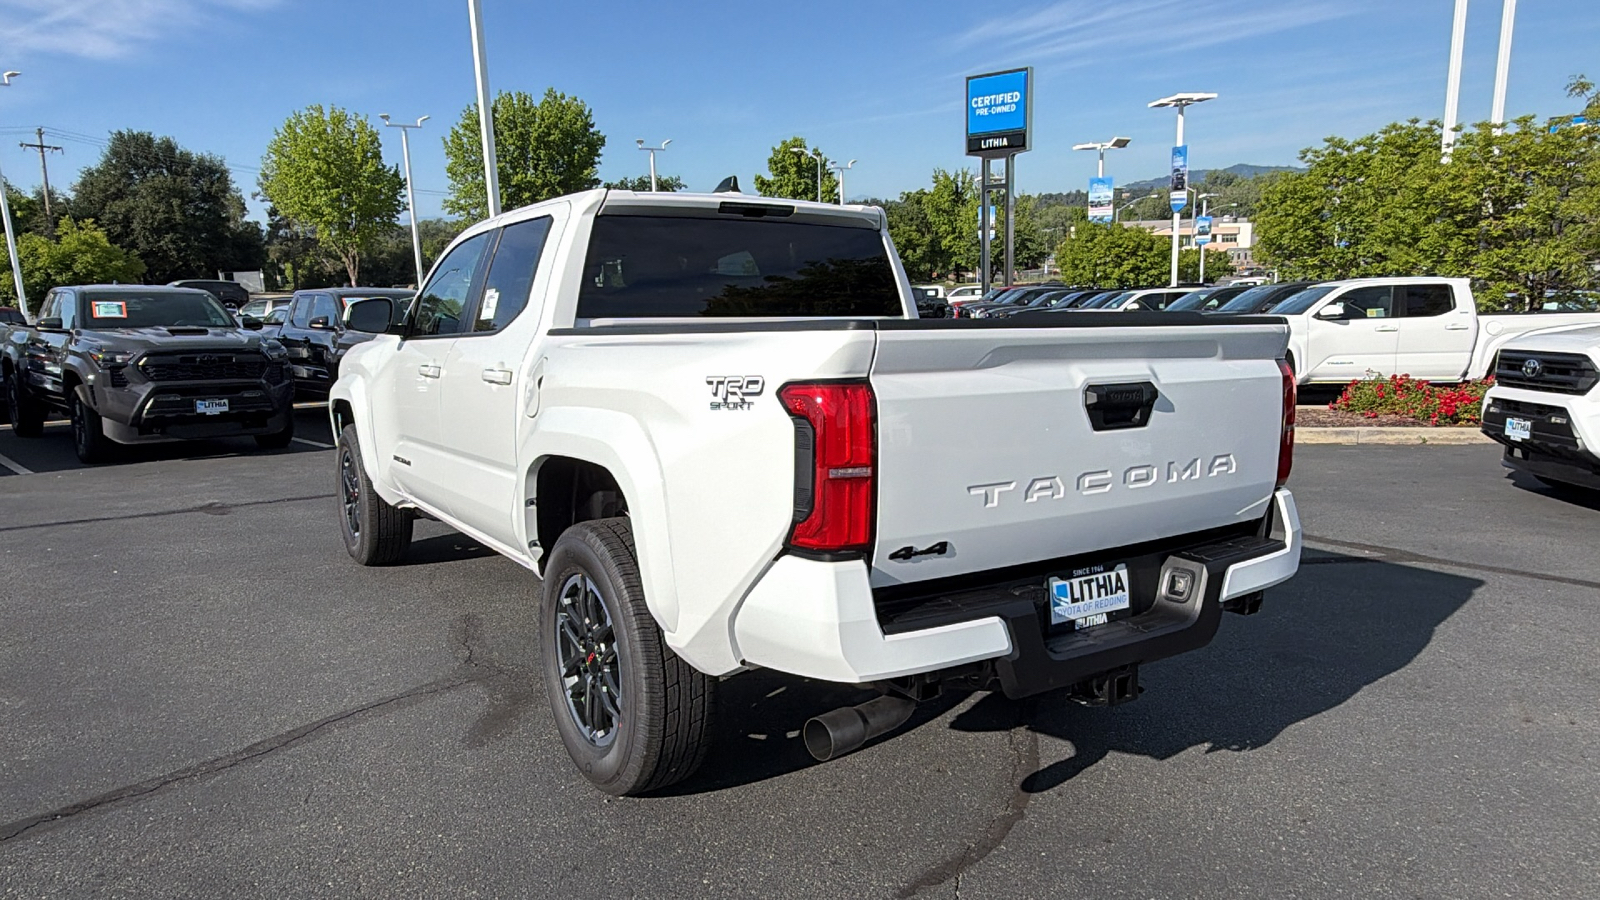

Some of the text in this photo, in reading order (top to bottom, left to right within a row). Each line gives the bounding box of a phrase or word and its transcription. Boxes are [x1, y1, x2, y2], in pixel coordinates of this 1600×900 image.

[971, 91, 1021, 108] CERTIFIED
[975, 103, 1017, 116] PRE-OWNED
[981, 137, 1008, 149] LITHIA
[706, 375, 765, 403] TRD
[204, 401, 228, 409] LITHIA
[709, 401, 755, 411] SPORT
[1511, 421, 1531, 432] LITHIA
[967, 453, 1237, 508] TACOMA
[1072, 564, 1104, 577] SINCE 1946
[1069, 571, 1126, 604] LITHIA
[1053, 595, 1127, 618] TOYOTA OF REDDING
[1081, 612, 1108, 628] LITHIA
